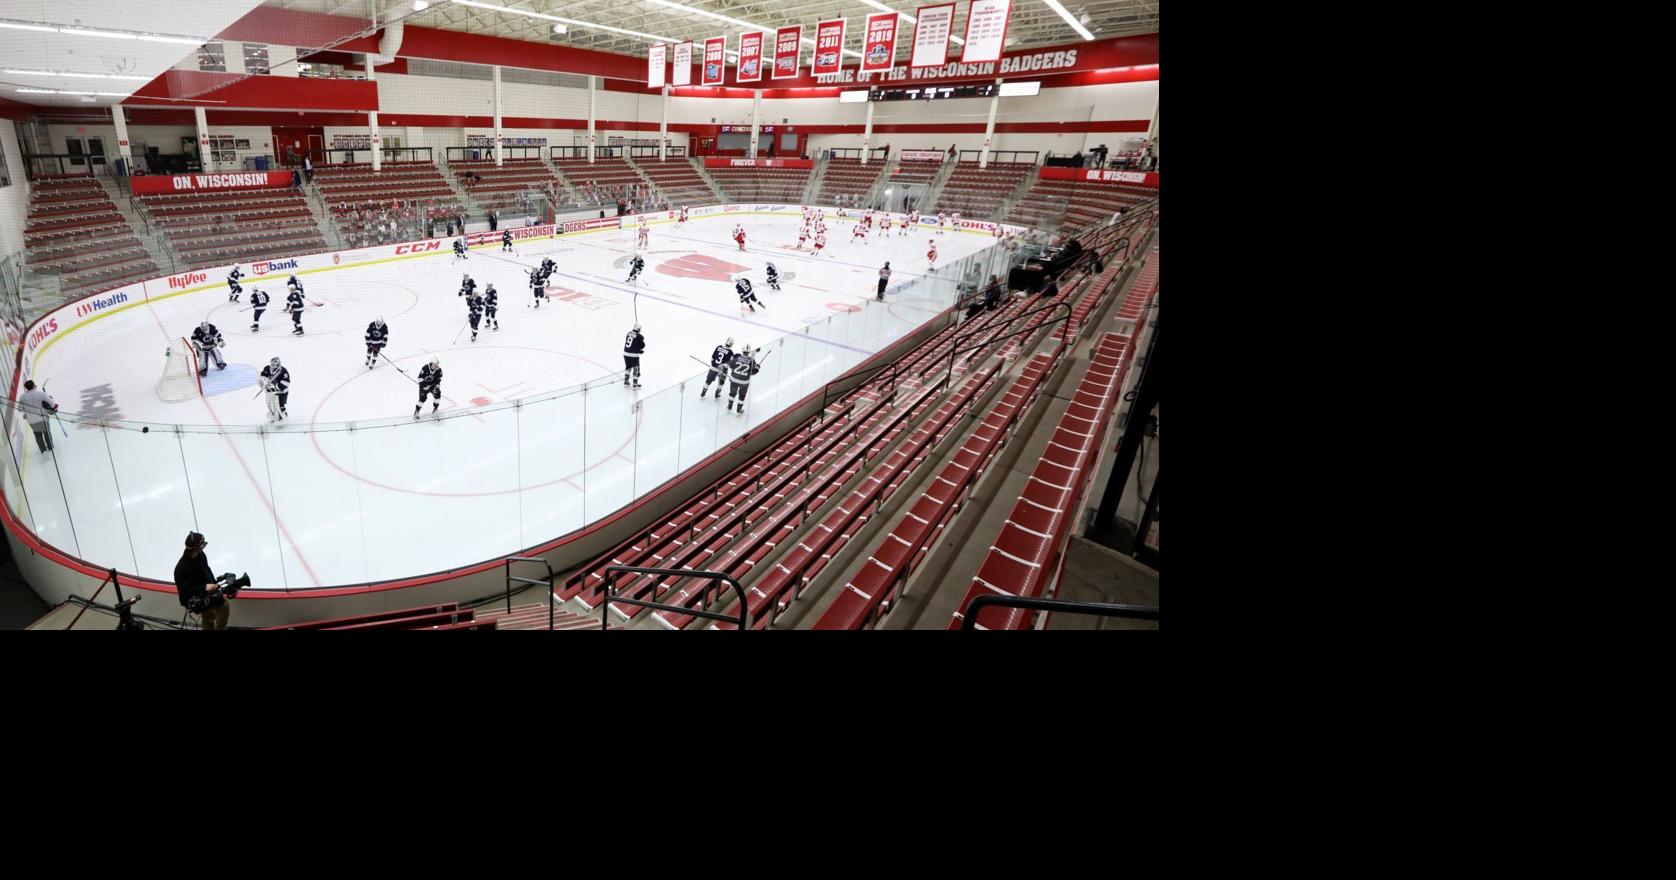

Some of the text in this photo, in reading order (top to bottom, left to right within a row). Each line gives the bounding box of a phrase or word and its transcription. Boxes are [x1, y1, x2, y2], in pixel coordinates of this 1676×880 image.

[819, 36, 839, 48] 2011
[869, 30, 892, 43] 2019
[742, 46, 759, 57] 2007
[778, 41, 796, 53] 2009
[817, 50, 1078, 84] HOME OF THE WISCONSIN BADGERS
[196, 173, 268, 189] WISCONSIN!
[513, 222, 587, 240] WISCONSIN DGERS
[961, 221, 994, 231] OHL'S
[395, 241, 441, 255] CCM
[625, 336, 633, 348] 9
[715, 352, 724, 364] 3
[733, 362, 750, 377] 22
